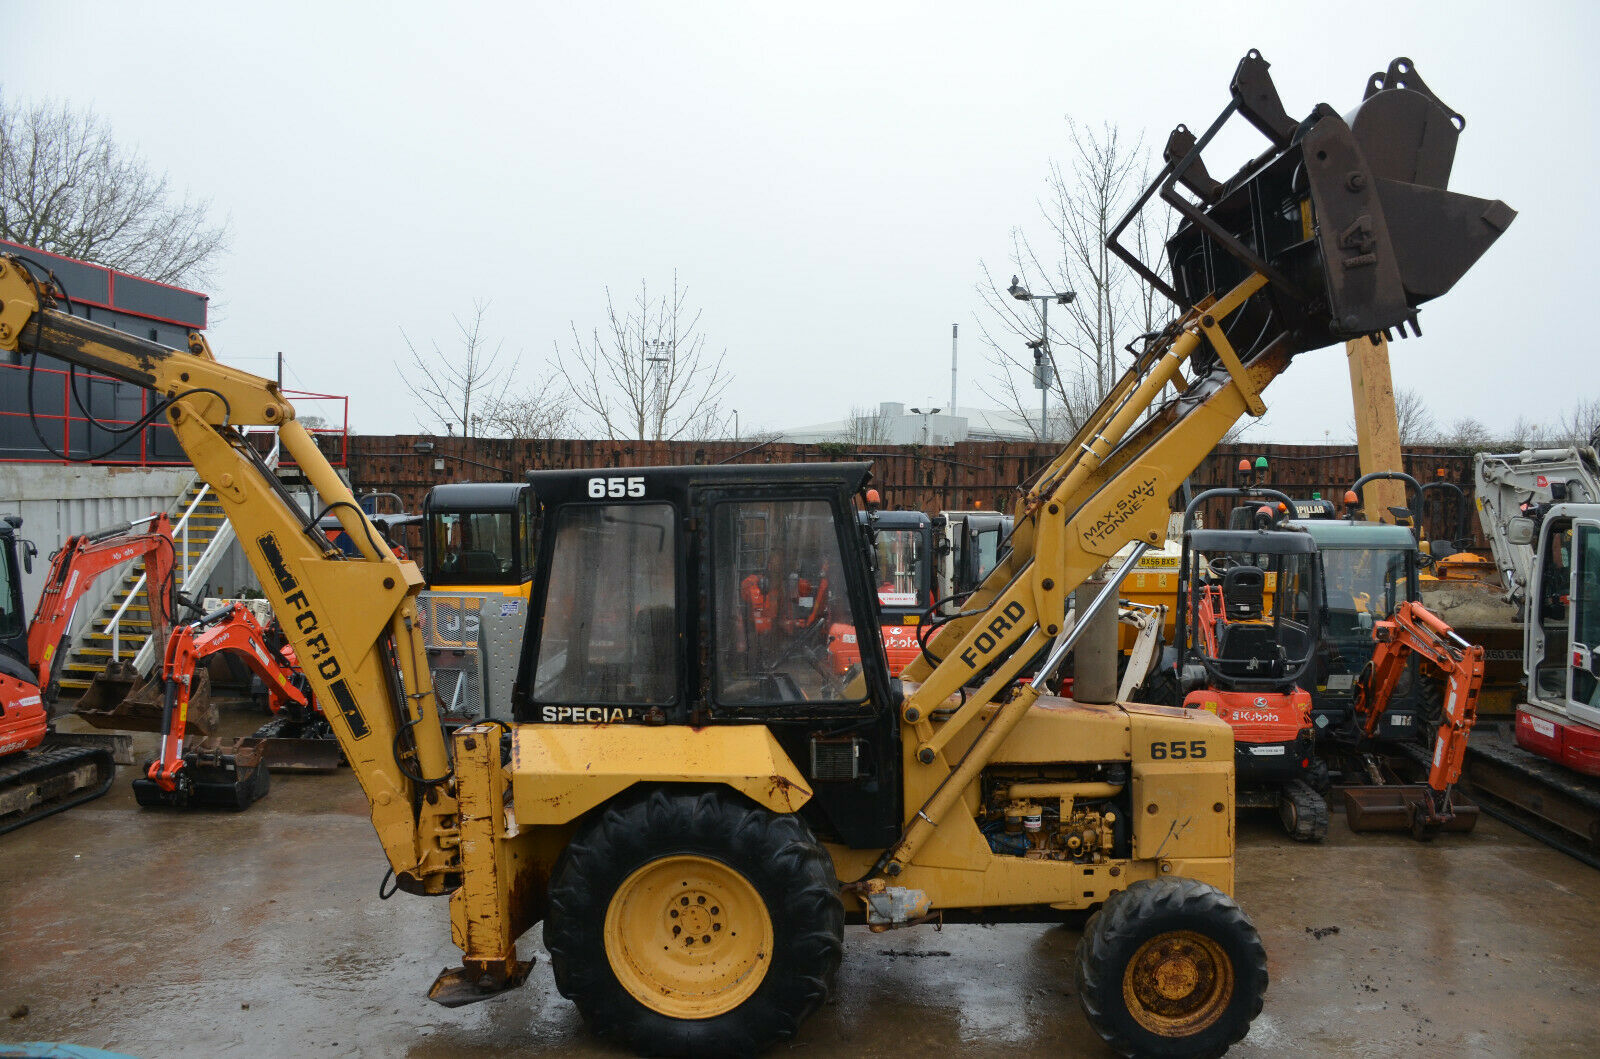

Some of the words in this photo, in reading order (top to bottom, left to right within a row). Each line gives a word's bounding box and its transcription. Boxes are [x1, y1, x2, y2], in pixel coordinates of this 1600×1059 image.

[588, 476, 646, 498] 655
[285, 589, 342, 681] FORD
[885, 637, 920, 648] ubota
[960, 601, 1026, 670] FORD
[1240, 711, 1279, 722] Kubota
[1150, 740, 1207, 760] 655
